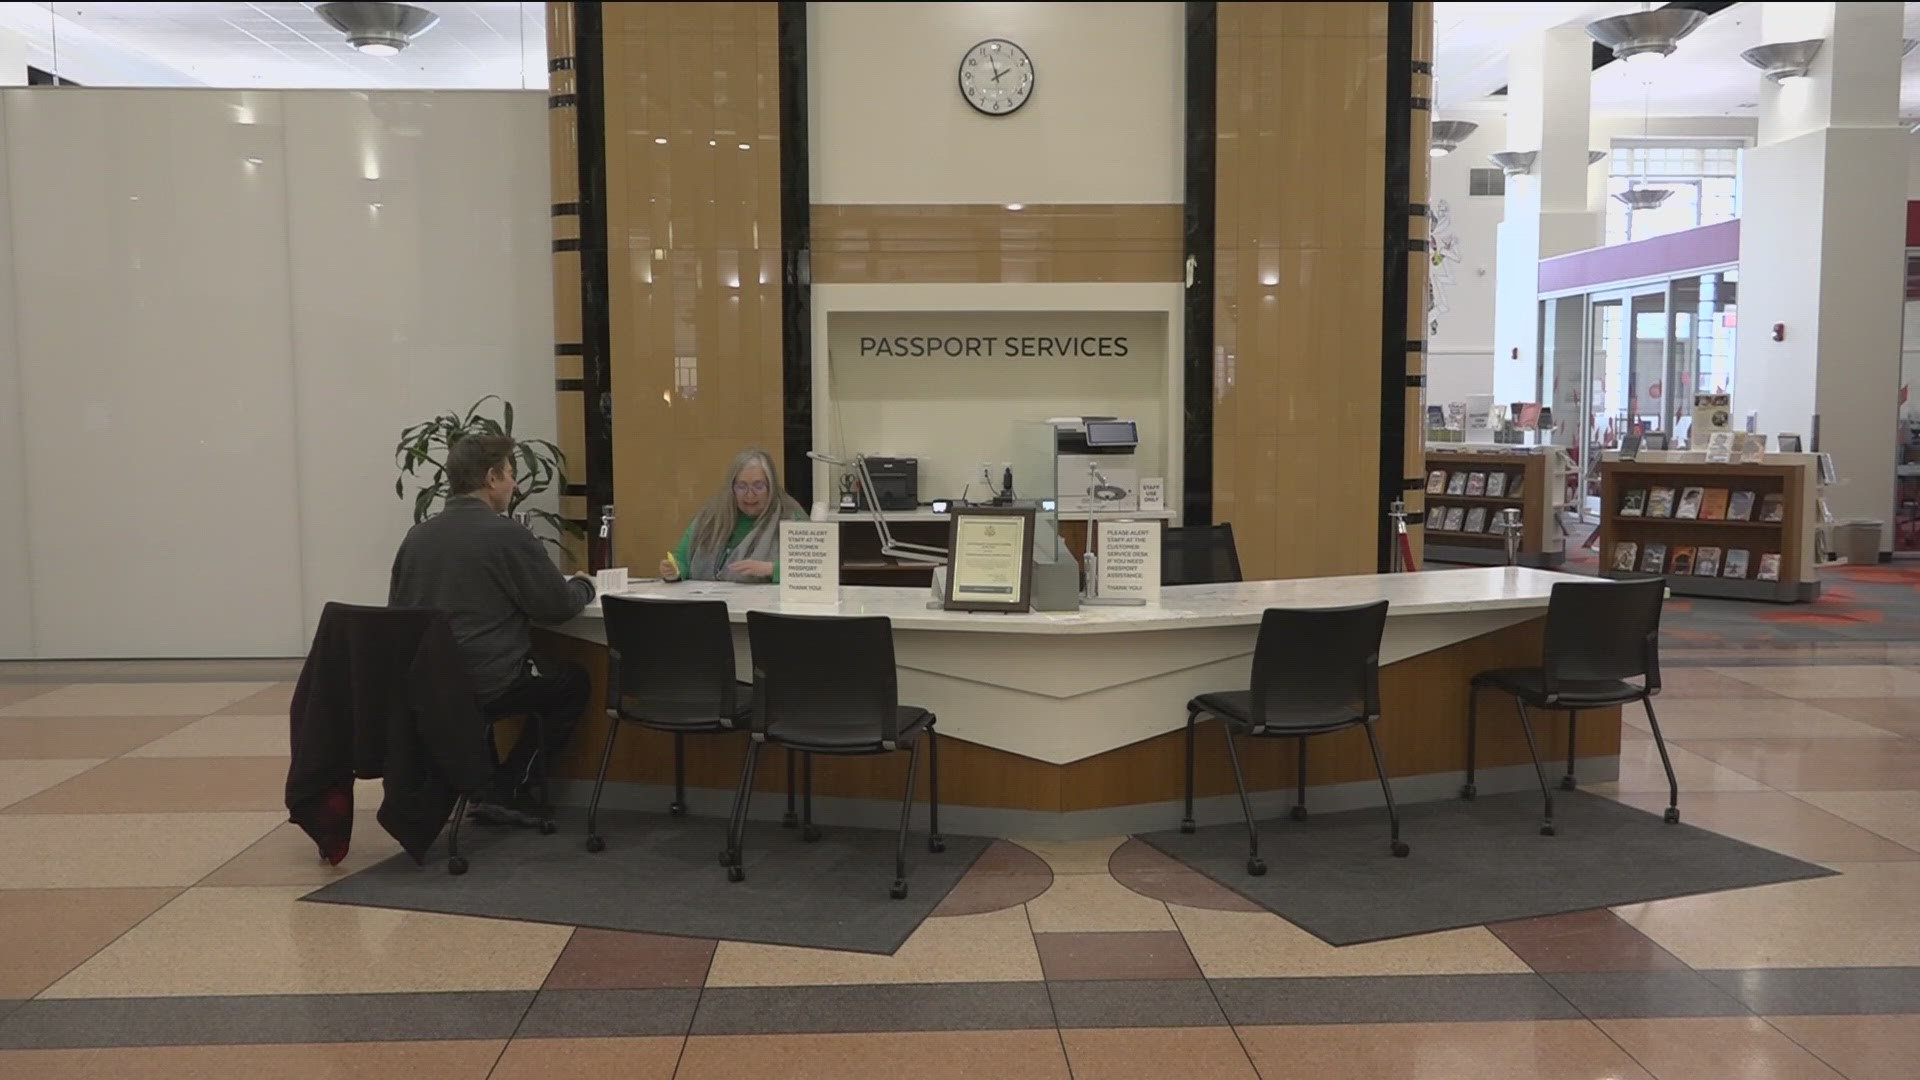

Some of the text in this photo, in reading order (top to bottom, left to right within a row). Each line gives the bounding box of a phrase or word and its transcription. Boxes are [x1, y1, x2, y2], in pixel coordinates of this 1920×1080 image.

[969, 87, 975, 96] 8
[993, 101, 999, 110] 6
[860, 337, 1129, 357] PASSPORT SERVICES
